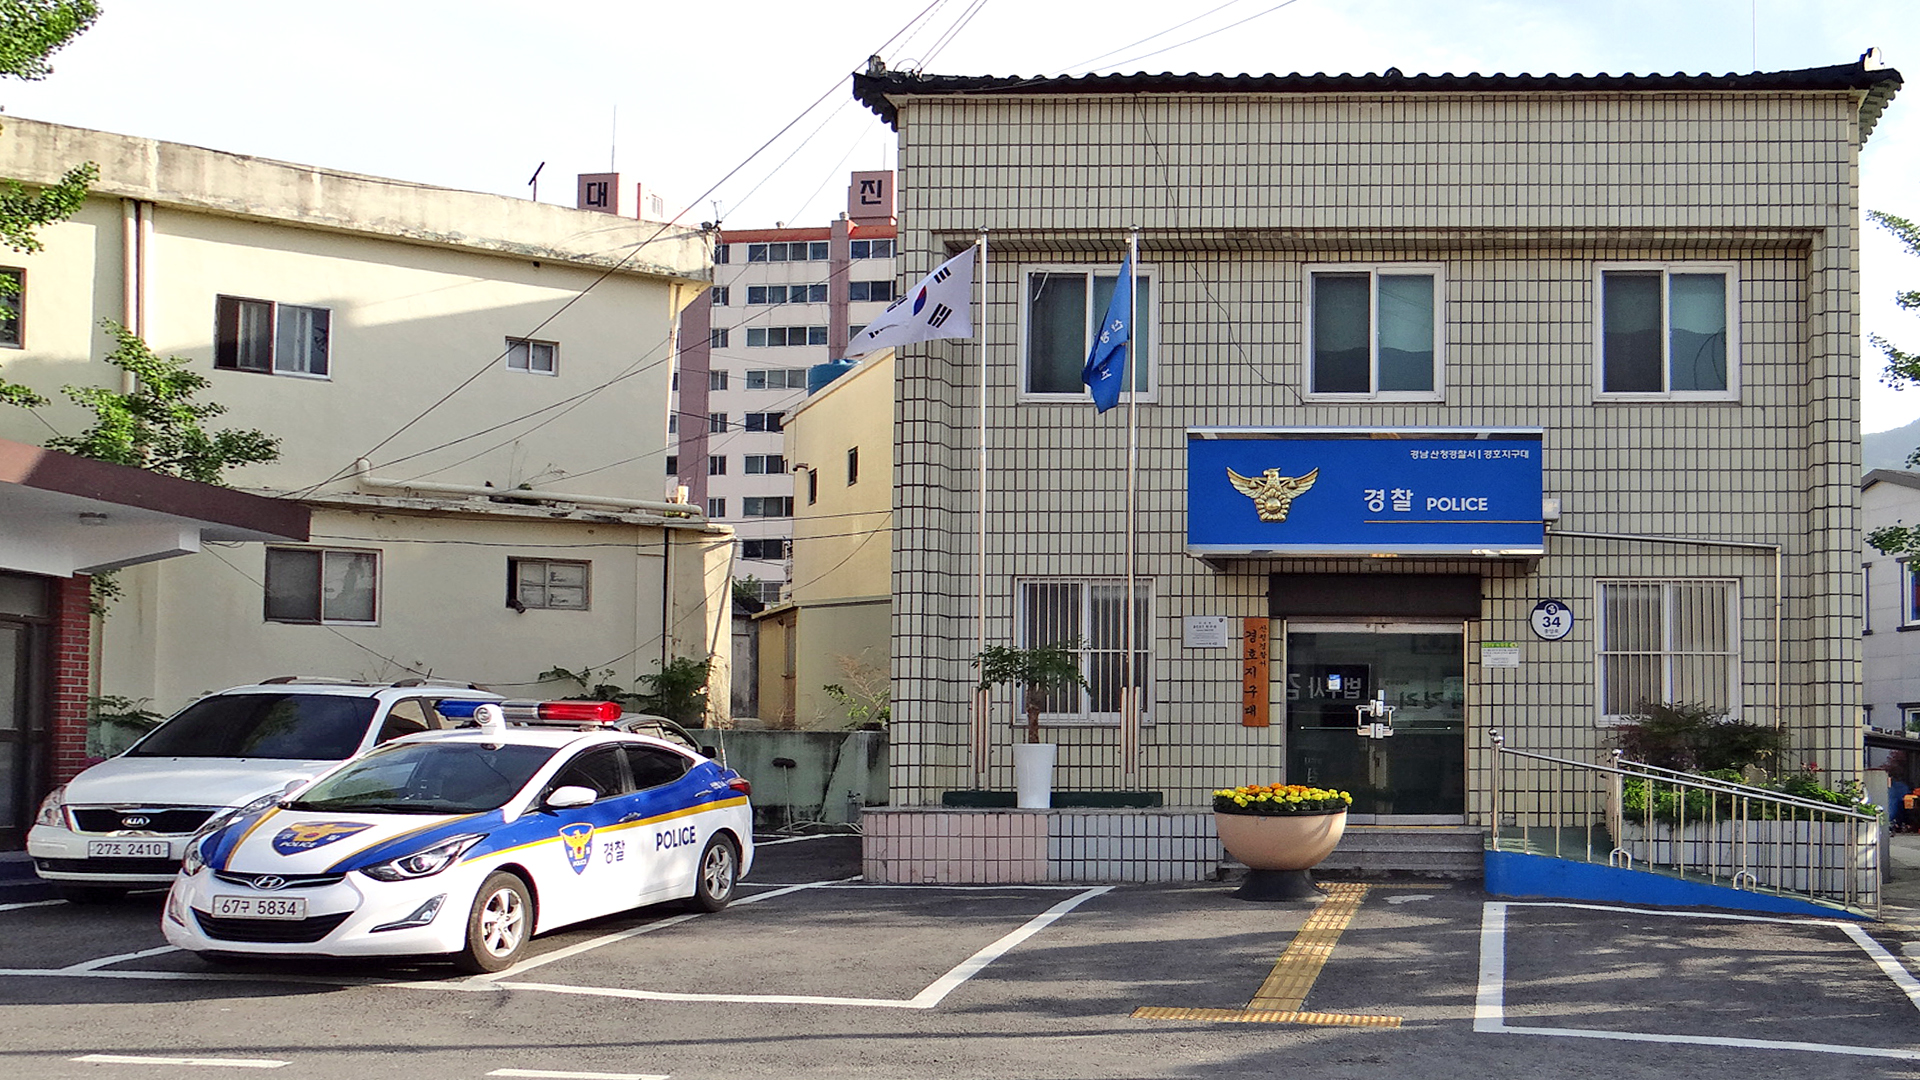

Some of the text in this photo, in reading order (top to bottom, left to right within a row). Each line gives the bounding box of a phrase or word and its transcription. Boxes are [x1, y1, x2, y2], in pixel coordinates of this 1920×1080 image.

[586, 181, 608, 208] 대
[860, 179, 883, 205] 진
[1483, 449, 1530, 460] 경호지구대
[1364, 488, 1488, 512] 경찰 POLICE
[1542, 616, 1561, 628] 34
[1244, 629, 1258, 718] 경호지구대
[96, 843, 161, 856] 27조 2410
[279, 840, 318, 848] POLICE
[603, 825, 697, 864] 경찰 POLICE
[221, 899, 297, 915] 67구 5834
